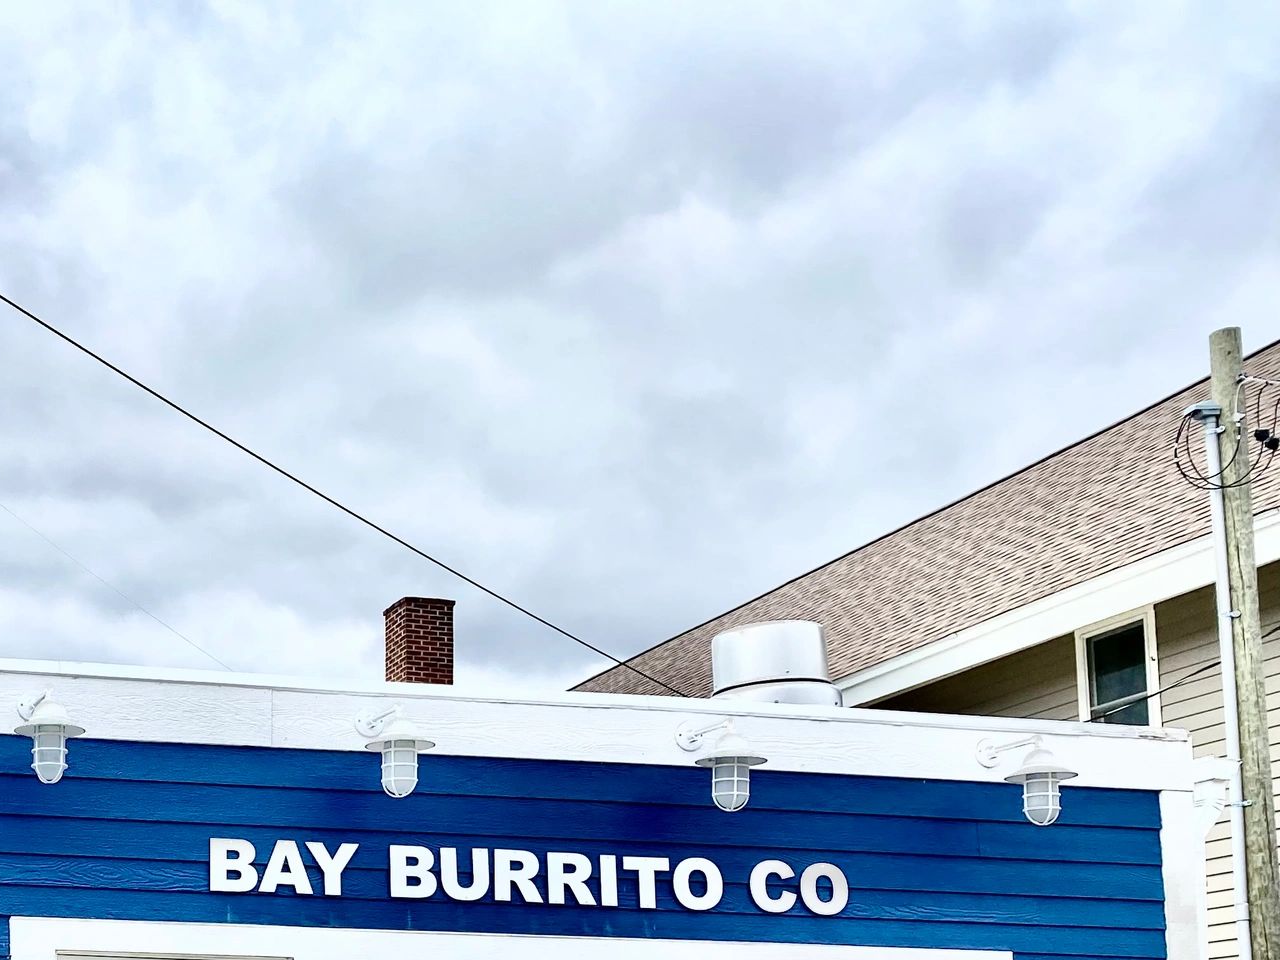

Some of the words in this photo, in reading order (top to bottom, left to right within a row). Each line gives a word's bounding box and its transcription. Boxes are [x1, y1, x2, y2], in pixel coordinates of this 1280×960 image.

[208, 837, 360, 897] BAY
[389, 845, 724, 912] BURRITO
[749, 860, 850, 916] CO
